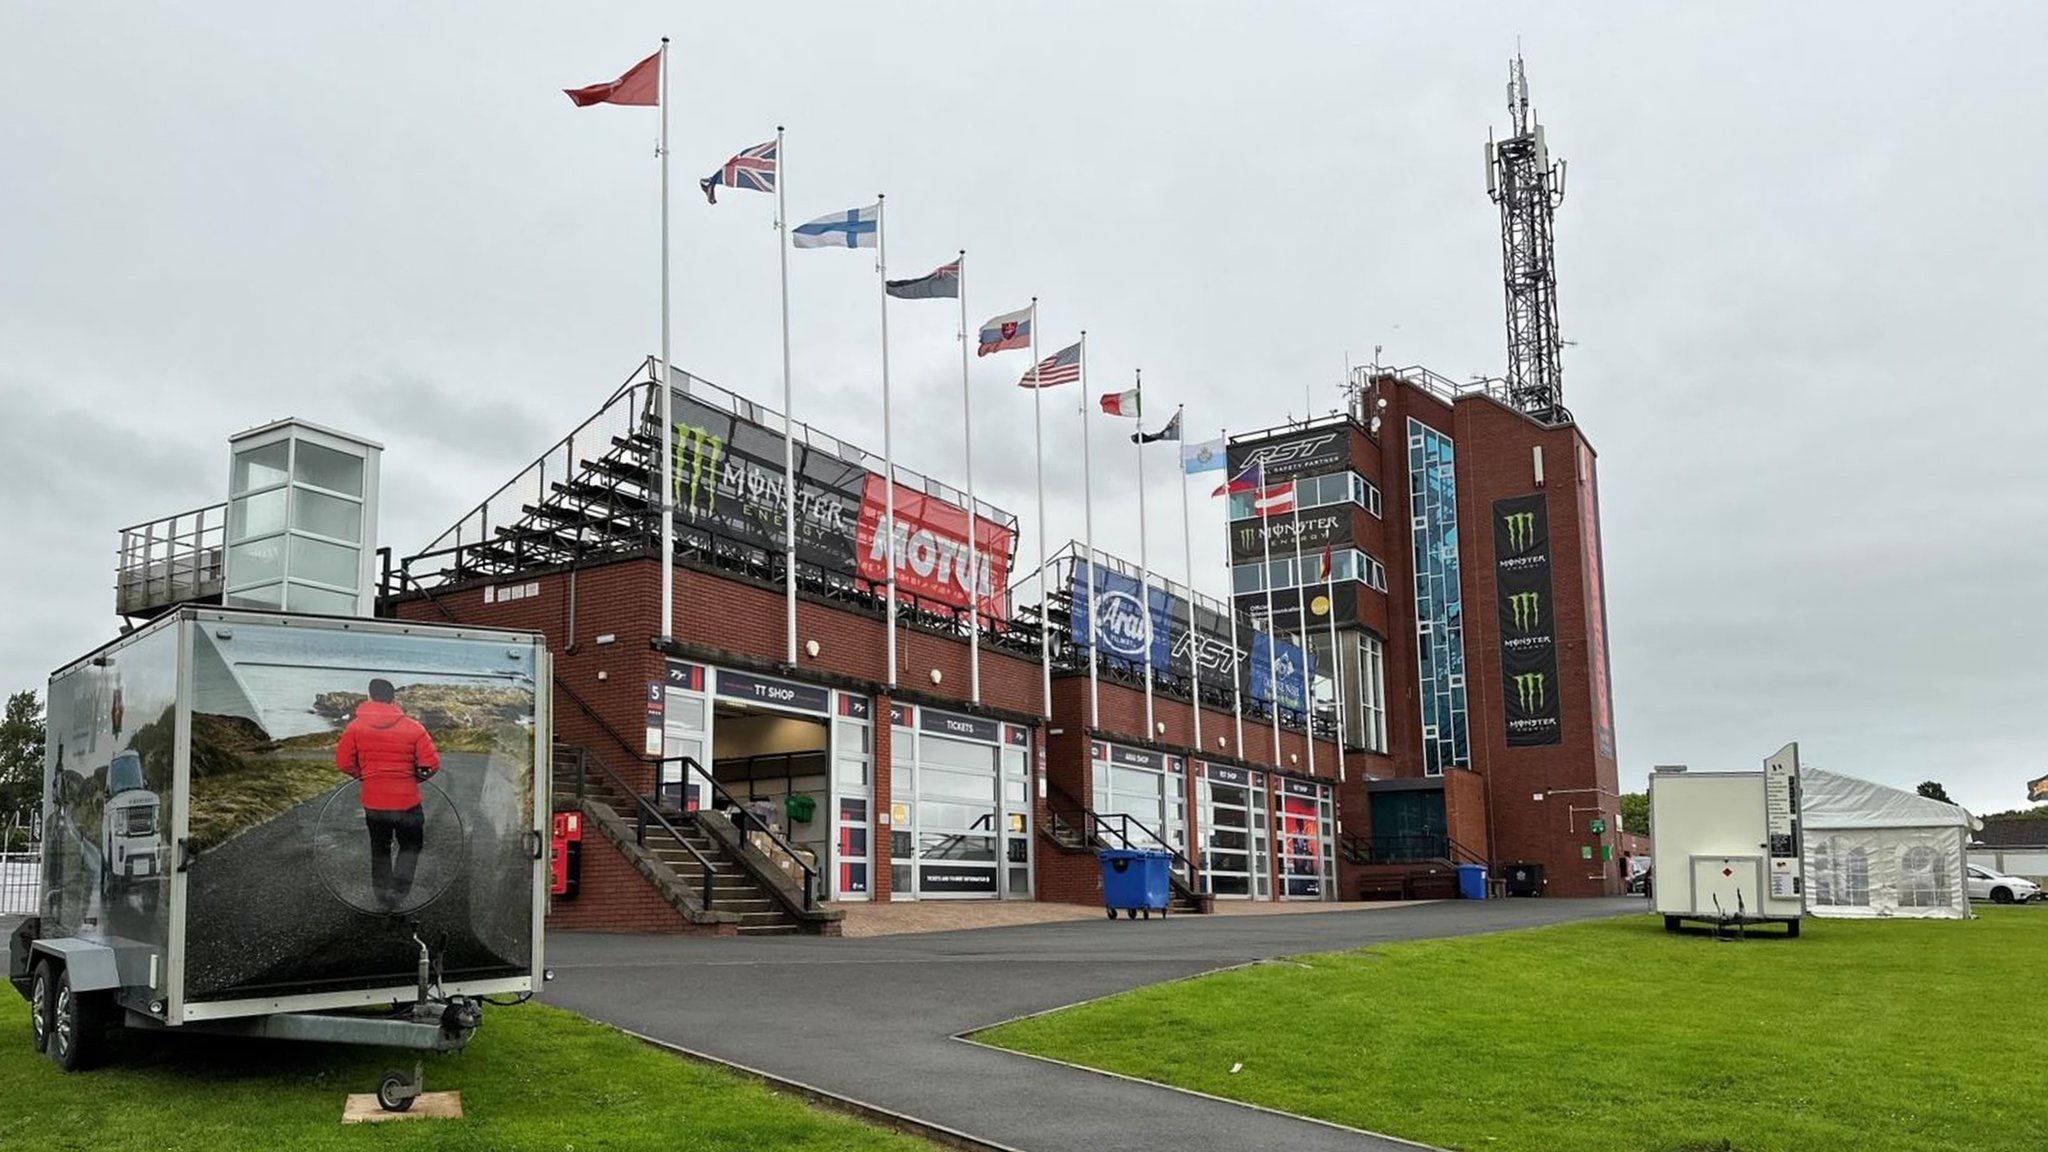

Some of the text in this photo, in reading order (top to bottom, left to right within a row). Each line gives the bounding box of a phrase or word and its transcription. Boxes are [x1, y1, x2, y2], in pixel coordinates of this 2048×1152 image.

[1239, 433, 1337, 469] RST
[1273, 463, 1302, 473] SAFETY
[1304, 456, 1339, 467] PARTNER
[743, 503, 826, 540] ENEGY
[1171, 630, 1248, 673] RST
[651, 685, 660, 700] 5
[754, 684, 796, 700] TT SHOP
[946, 720, 974, 733] TICKETS
